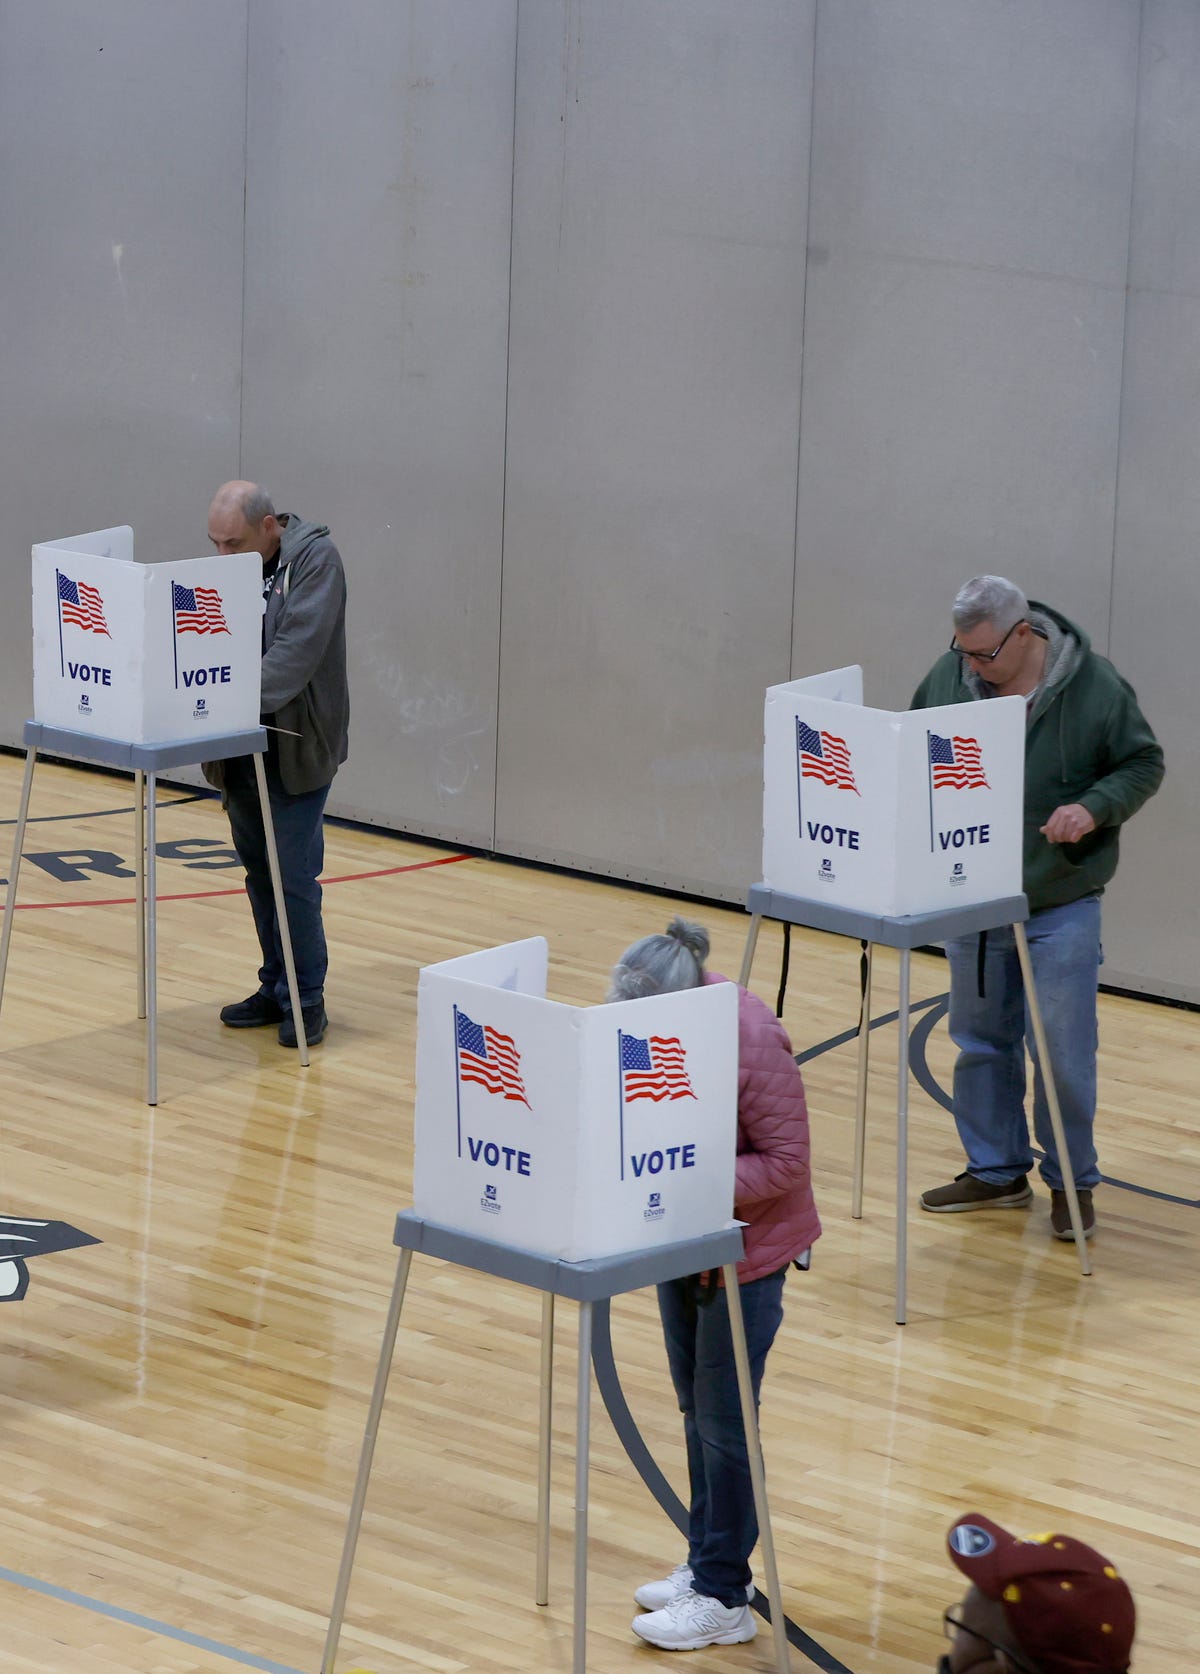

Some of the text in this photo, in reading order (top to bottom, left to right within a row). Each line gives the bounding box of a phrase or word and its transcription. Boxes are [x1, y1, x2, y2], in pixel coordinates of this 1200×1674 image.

[68, 662, 111, 686] VOTE
[183, 666, 230, 687] VOTE
[808, 822, 859, 850] VOTE
[939, 825, 989, 850] VOTE
[468, 1137, 530, 1176] VOTE
[631, 1144, 695, 1177] VOTE
[480, 1198, 502, 1211] EZvote
[643, 1207, 666, 1218] EZvote
